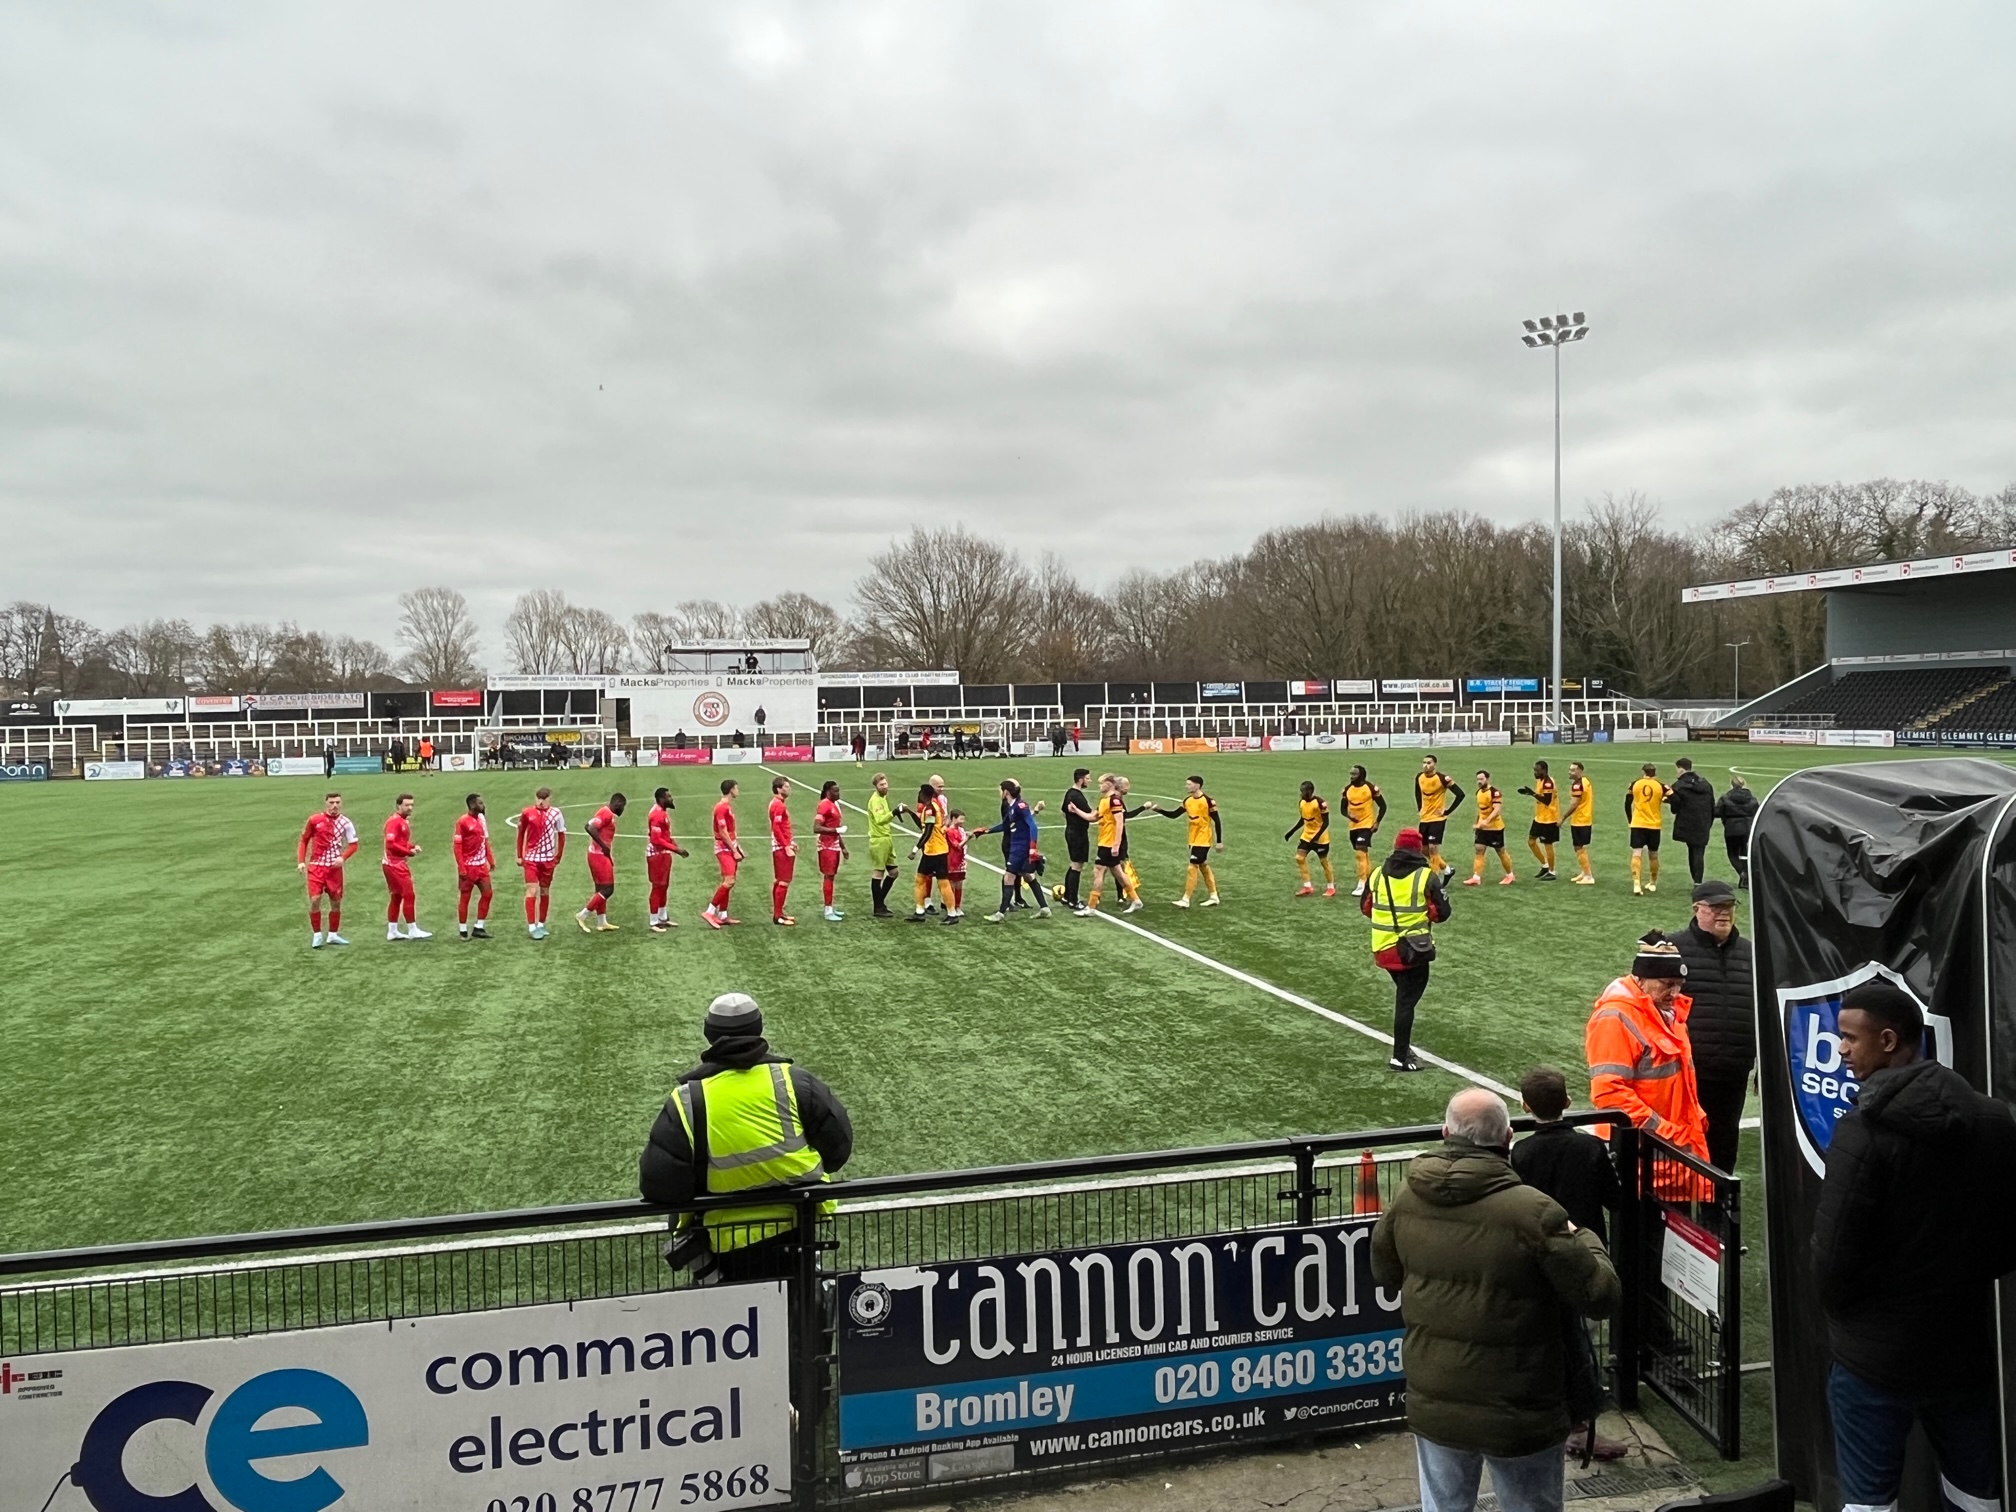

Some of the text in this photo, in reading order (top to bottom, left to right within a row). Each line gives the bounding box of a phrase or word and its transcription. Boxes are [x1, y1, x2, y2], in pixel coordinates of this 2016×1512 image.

[620, 677, 710, 689] MacksProperties
[727, 676, 814, 688] MacksProperties
[1941, 731, 1984, 740] GLEMNET
[1642, 784, 1654, 803] 9
[425, 1306, 760, 1395] command
[1051, 1327, 1294, 1367] 24 HOUR LICENSED MINI CAB AND COURIER SERVICE
[1155, 1337, 1404, 1404] 020 8460 3333
[916, 1380, 1075, 1432] Bromley
[1297, 1398, 1380, 1420] @CannonCars
[448, 1387, 742, 1474] electrical
[898, 1444, 930, 1457] Android
[931, 1439, 964, 1453] Booking
[965, 1437, 981, 1448] App
[982, 1433, 1020, 1446] Available
[1030, 1407, 1266, 1456] www.cannoncars.co.uk
[573, 1477, 665, 1512] 8777
[680, 1464, 770, 1505] 5868
[865, 1469, 921, 1486] App Store
